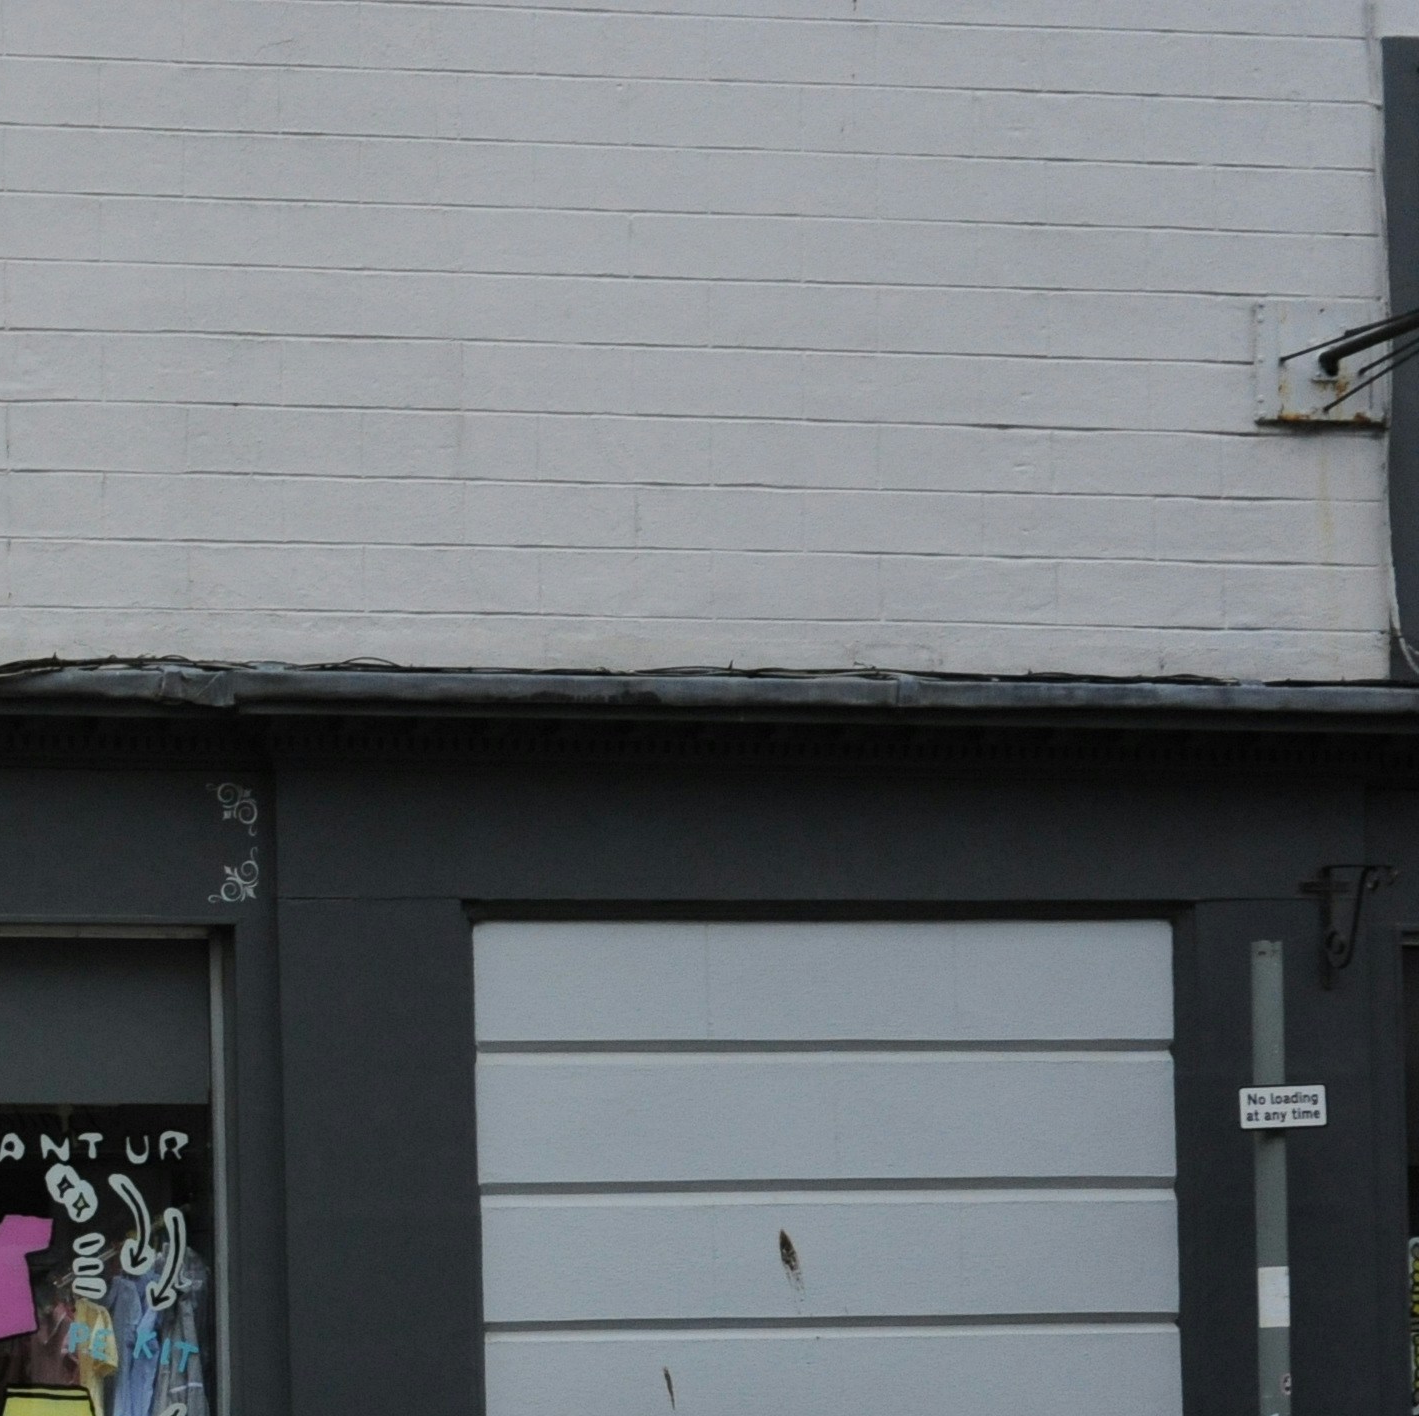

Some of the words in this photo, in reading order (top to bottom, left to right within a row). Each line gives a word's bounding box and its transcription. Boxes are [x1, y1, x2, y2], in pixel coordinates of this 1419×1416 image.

[1247, 1093, 1266, 1105] No
[1270, 1092, 1318, 1105] loading
[1246, 1110, 1259, 1121] at
[1264, 1110, 1287, 1122] any
[1291, 1108, 1321, 1120] time
[126, 1130, 189, 1164] UR
[68, 1321, 111, 1362] PE
[133, 1331, 200, 1373] KIT
